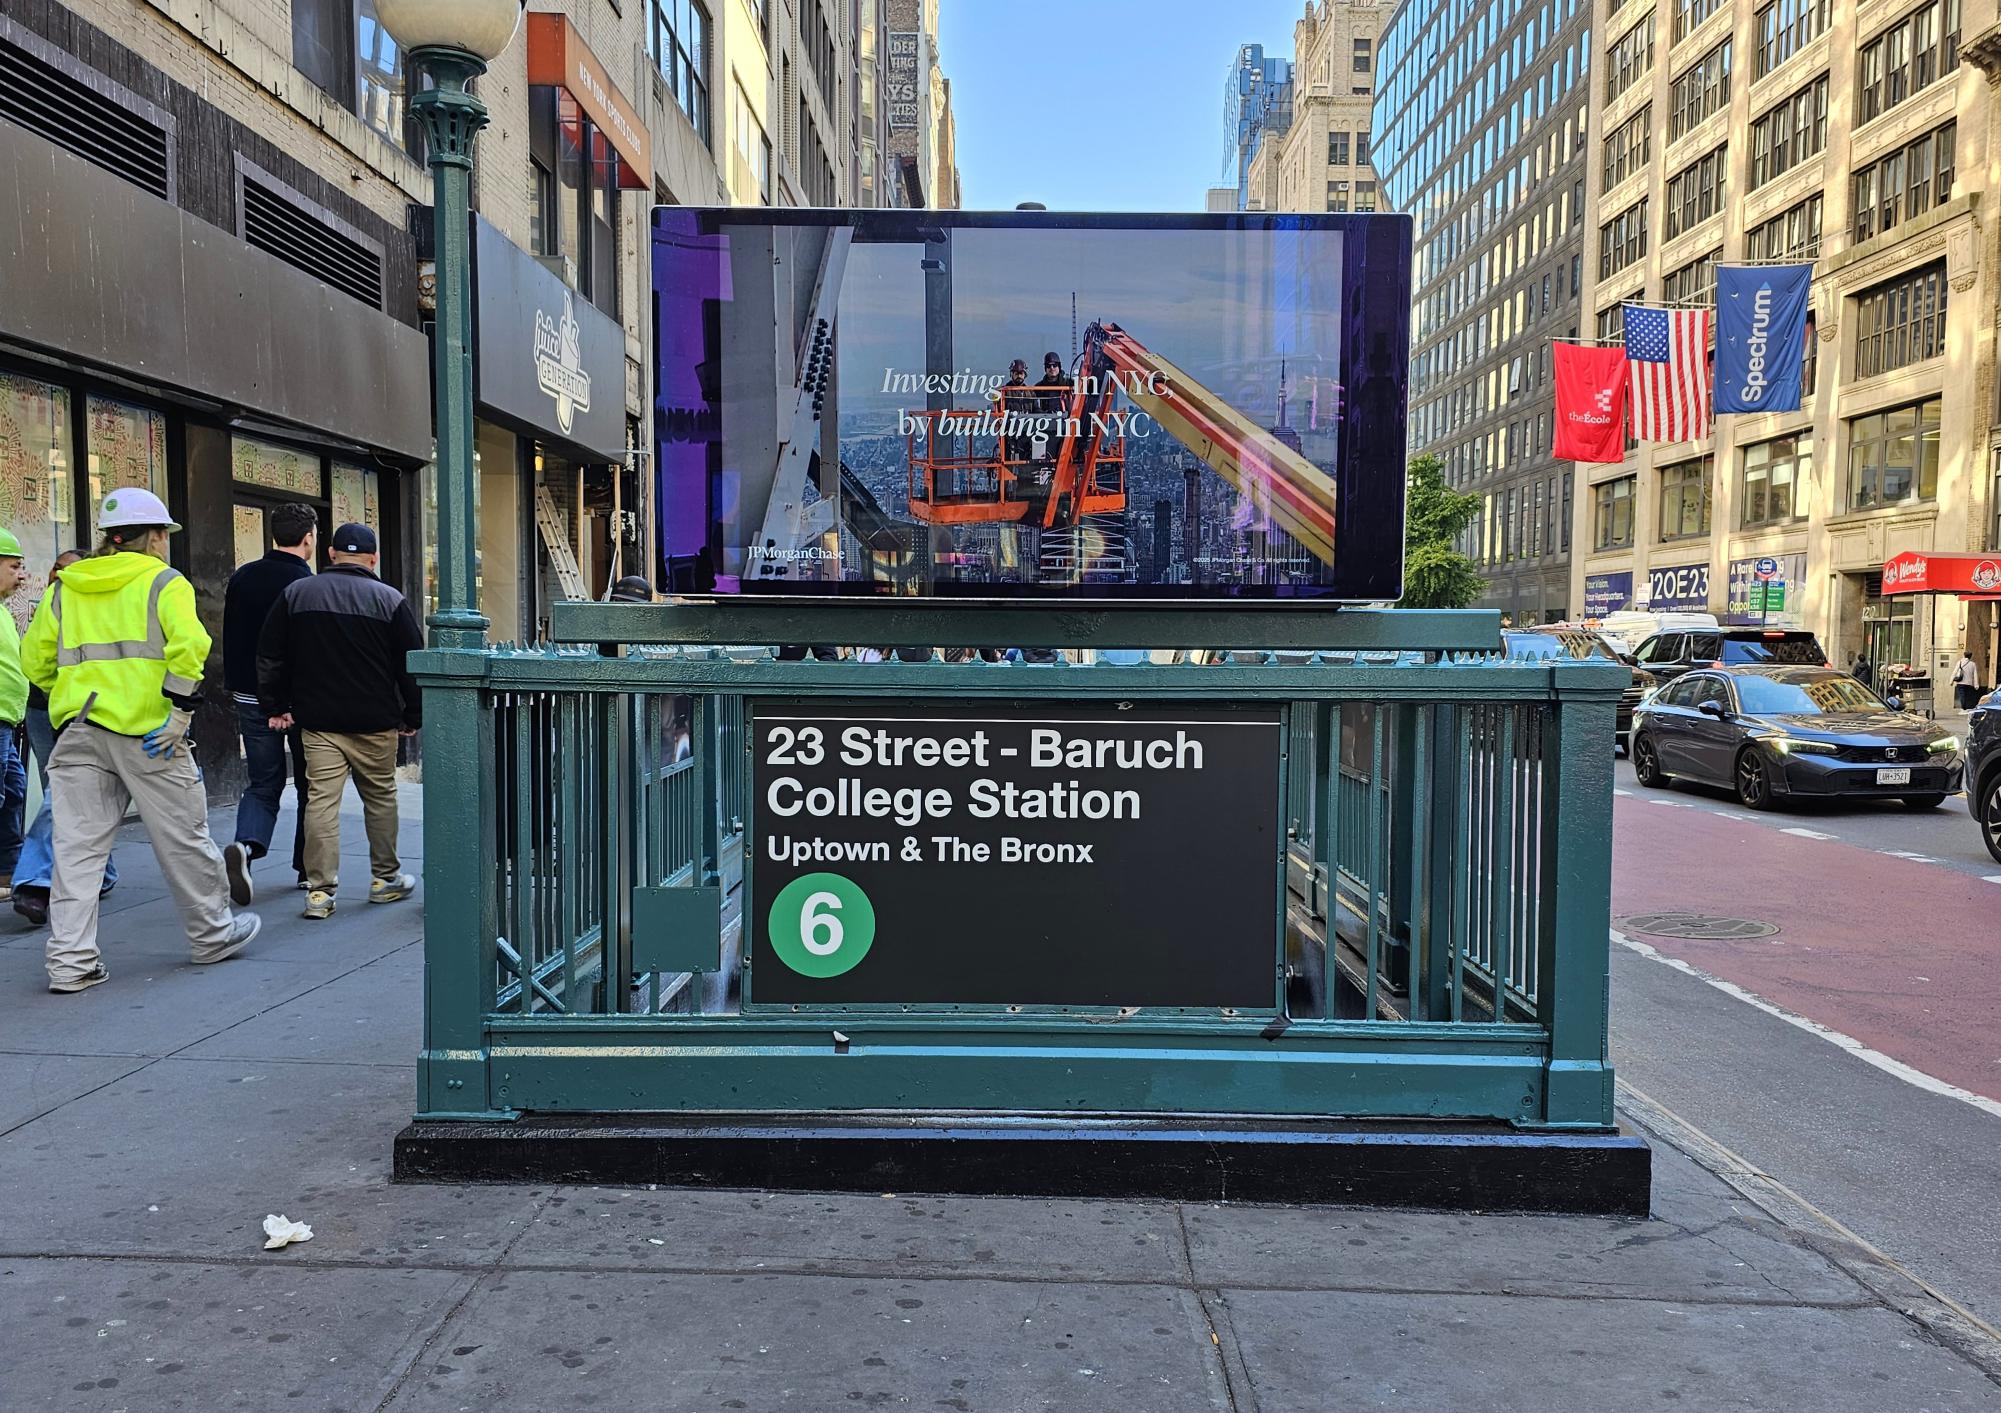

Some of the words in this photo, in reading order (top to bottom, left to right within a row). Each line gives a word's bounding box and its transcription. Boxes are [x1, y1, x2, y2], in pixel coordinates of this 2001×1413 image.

[578, 61, 592, 90] NEW
[592, 81, 607, 112] YORK
[607, 100, 626, 136] SPORTS
[626, 126, 641, 156] CLUBS
[536, 317, 561, 358] juice
[1740, 289, 1772, 402] Spectrum
[541, 359, 587, 400] GENERATION
[880, 367, 1005, 401] Investing
[1074, 368, 1099, 396] in
[1105, 369, 1175, 400] NYC,
[898, 407, 933, 443] by
[938, 409, 1051, 444] building
[1056, 411, 1082, 438] in
[1090, 412, 1150, 438] NYC
[1568, 411, 1611, 424] theÉcole
[747, 545, 845, 562] JPMorganChase
[1730, 565, 1736, 575] A
[1737, 563, 1752, 575] Rare
[1586, 581, 1595, 589] Your
[1586, 593, 1595, 602] Your
[1586, 605, 1595, 614] Your
[766, 725, 825, 767] 23
[839, 726, 990, 768] Street
[1030, 729, 1204, 769] Baruch
[767, 775, 953, 827] College
[967, 778, 1141, 819] Station
[767, 835, 890, 866] Uptown
[900, 836, 923, 863] &
[931, 836, 990, 863] The
[1000, 836, 1094, 864] Bronx
[799, 891, 844, 956] 6
